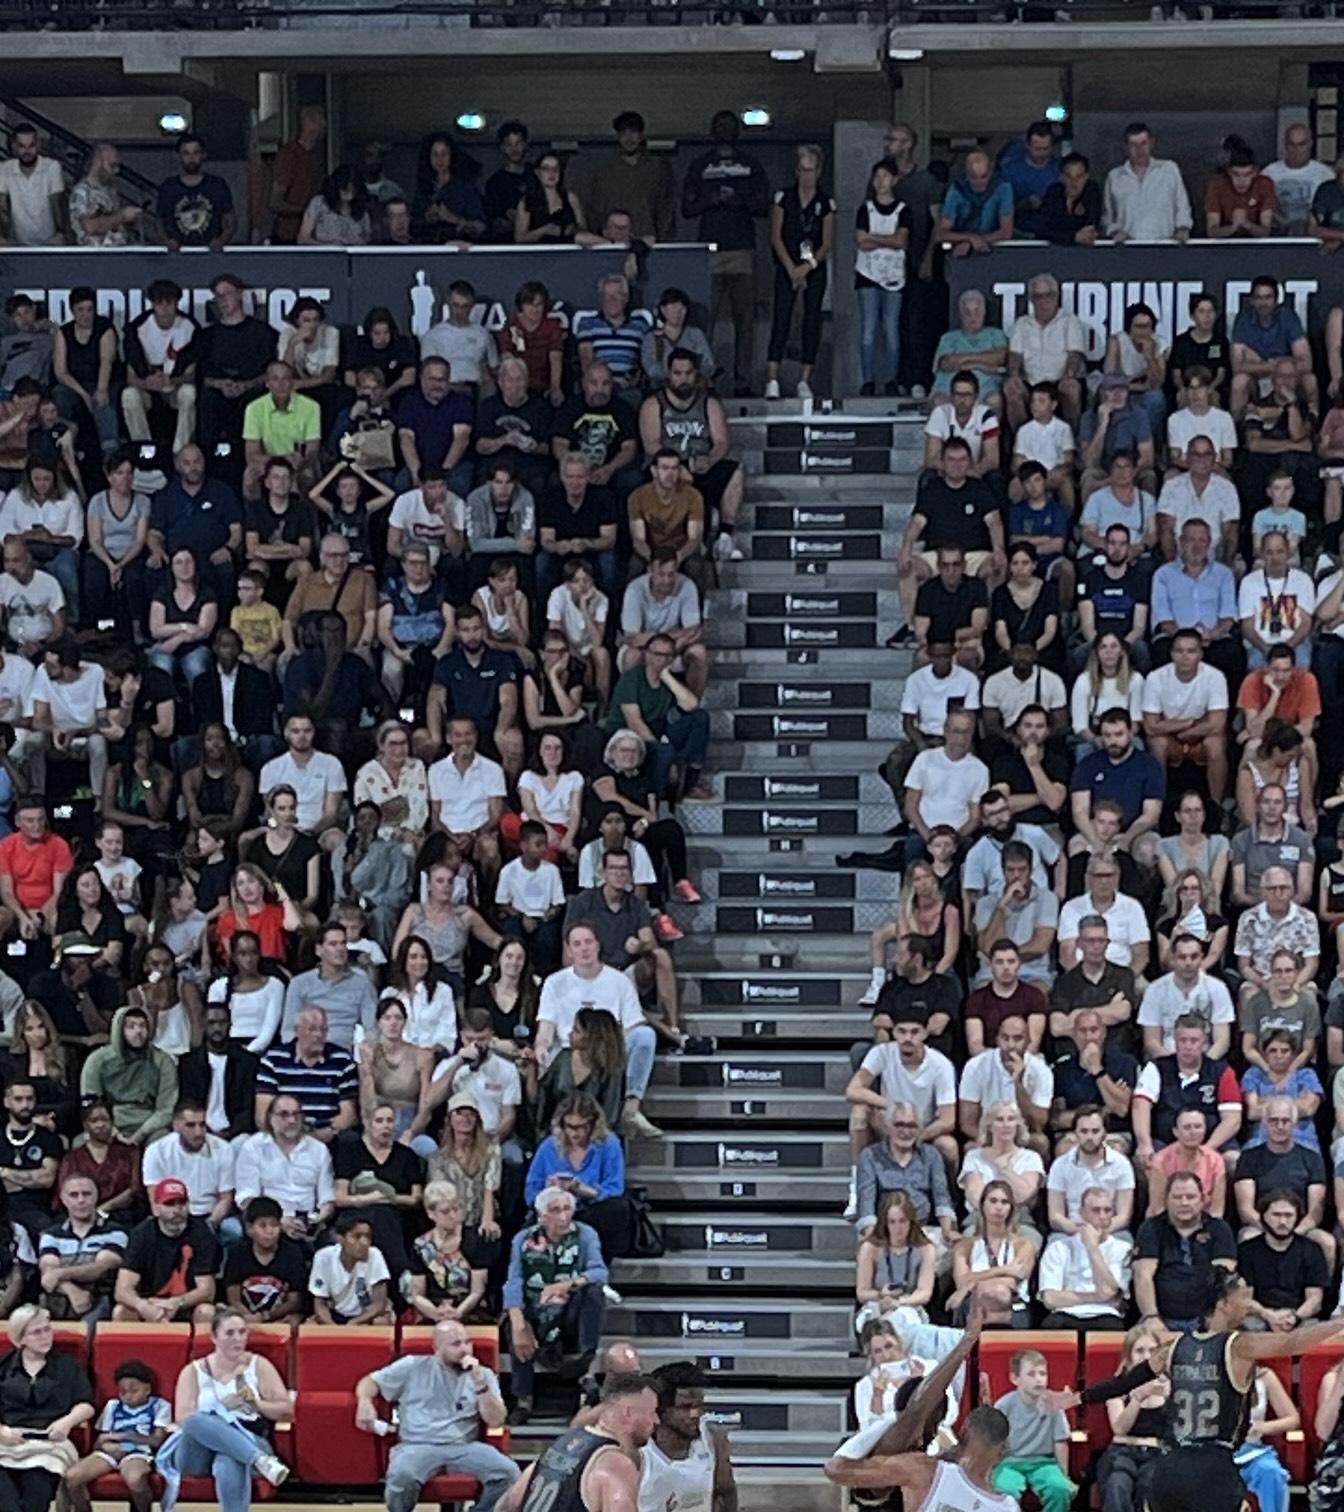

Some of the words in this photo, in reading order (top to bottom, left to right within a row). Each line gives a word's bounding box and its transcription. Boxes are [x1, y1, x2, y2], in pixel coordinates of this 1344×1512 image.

[993, 280, 1205, 362] TIBUNE
[1225, 280, 1319, 350] ET
[1172, 1389, 1221, 1440] 32
